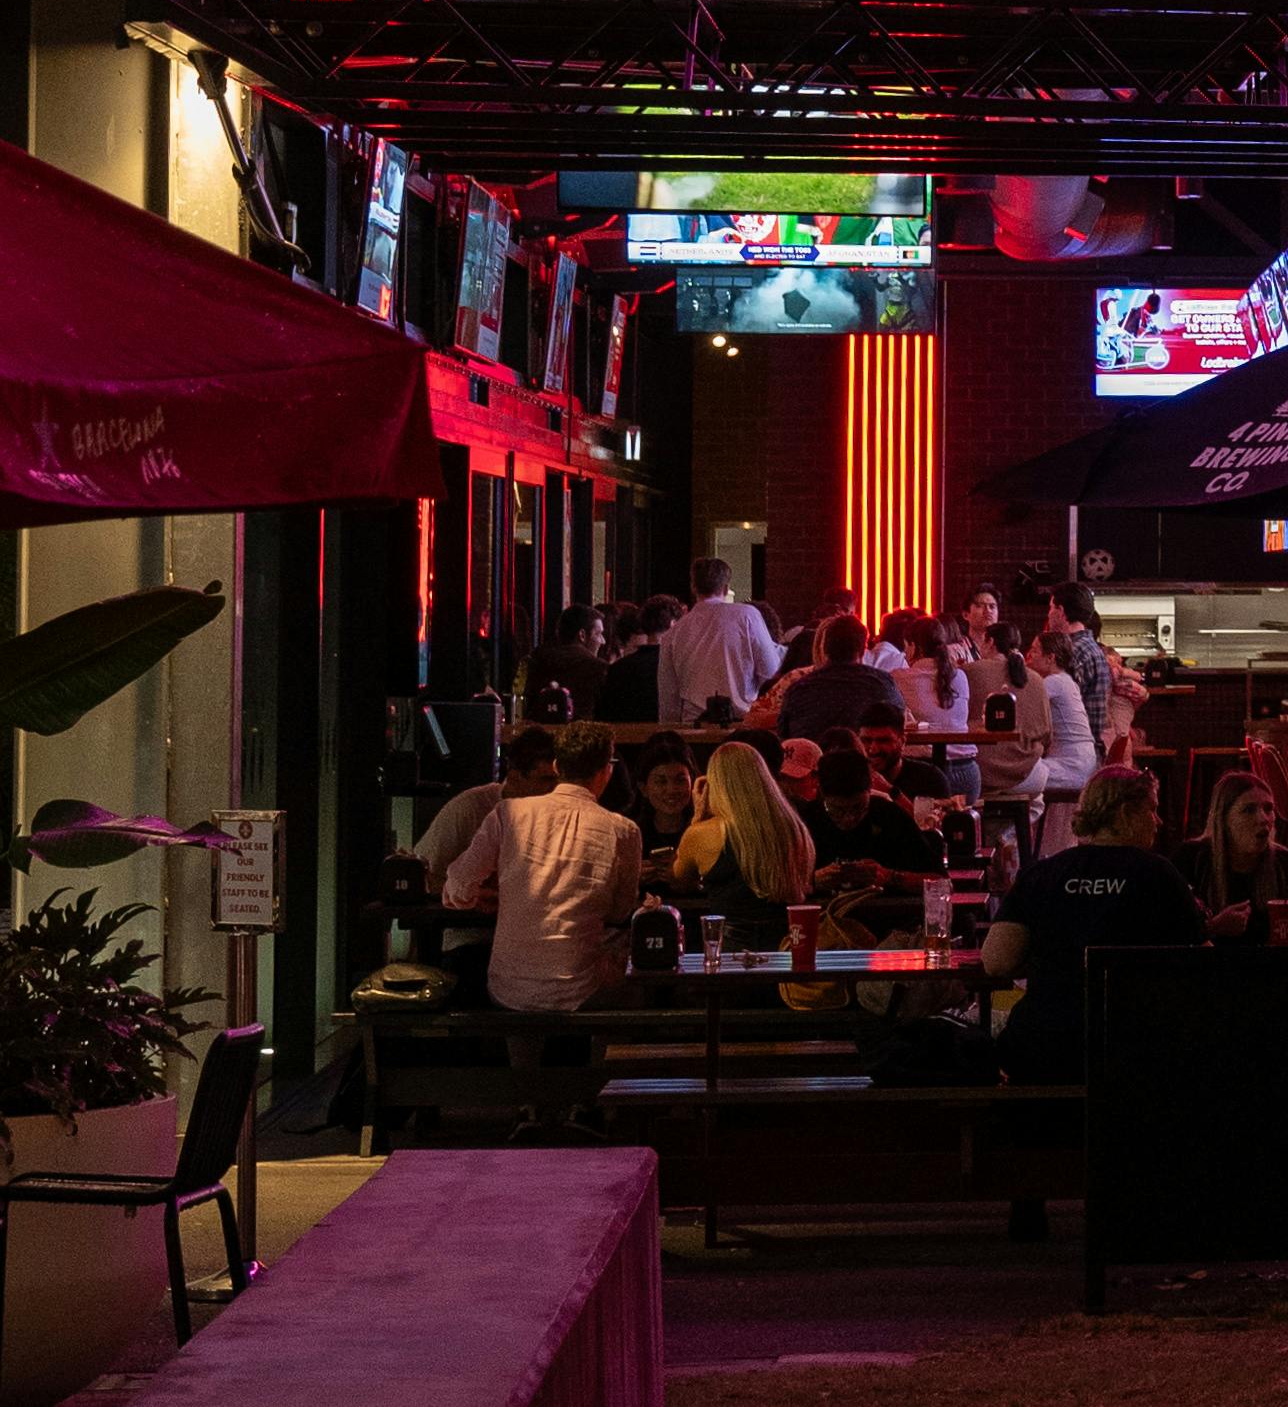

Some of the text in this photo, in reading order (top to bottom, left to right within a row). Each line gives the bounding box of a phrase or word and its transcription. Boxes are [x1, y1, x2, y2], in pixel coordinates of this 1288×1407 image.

[1228, 421, 1253, 442] 4
[1205, 471, 1250, 493] CO.
[226, 872, 265, 883] FRIENDLY
[1064, 878, 1127, 895] CREW
[645, 937, 664, 949] 73
